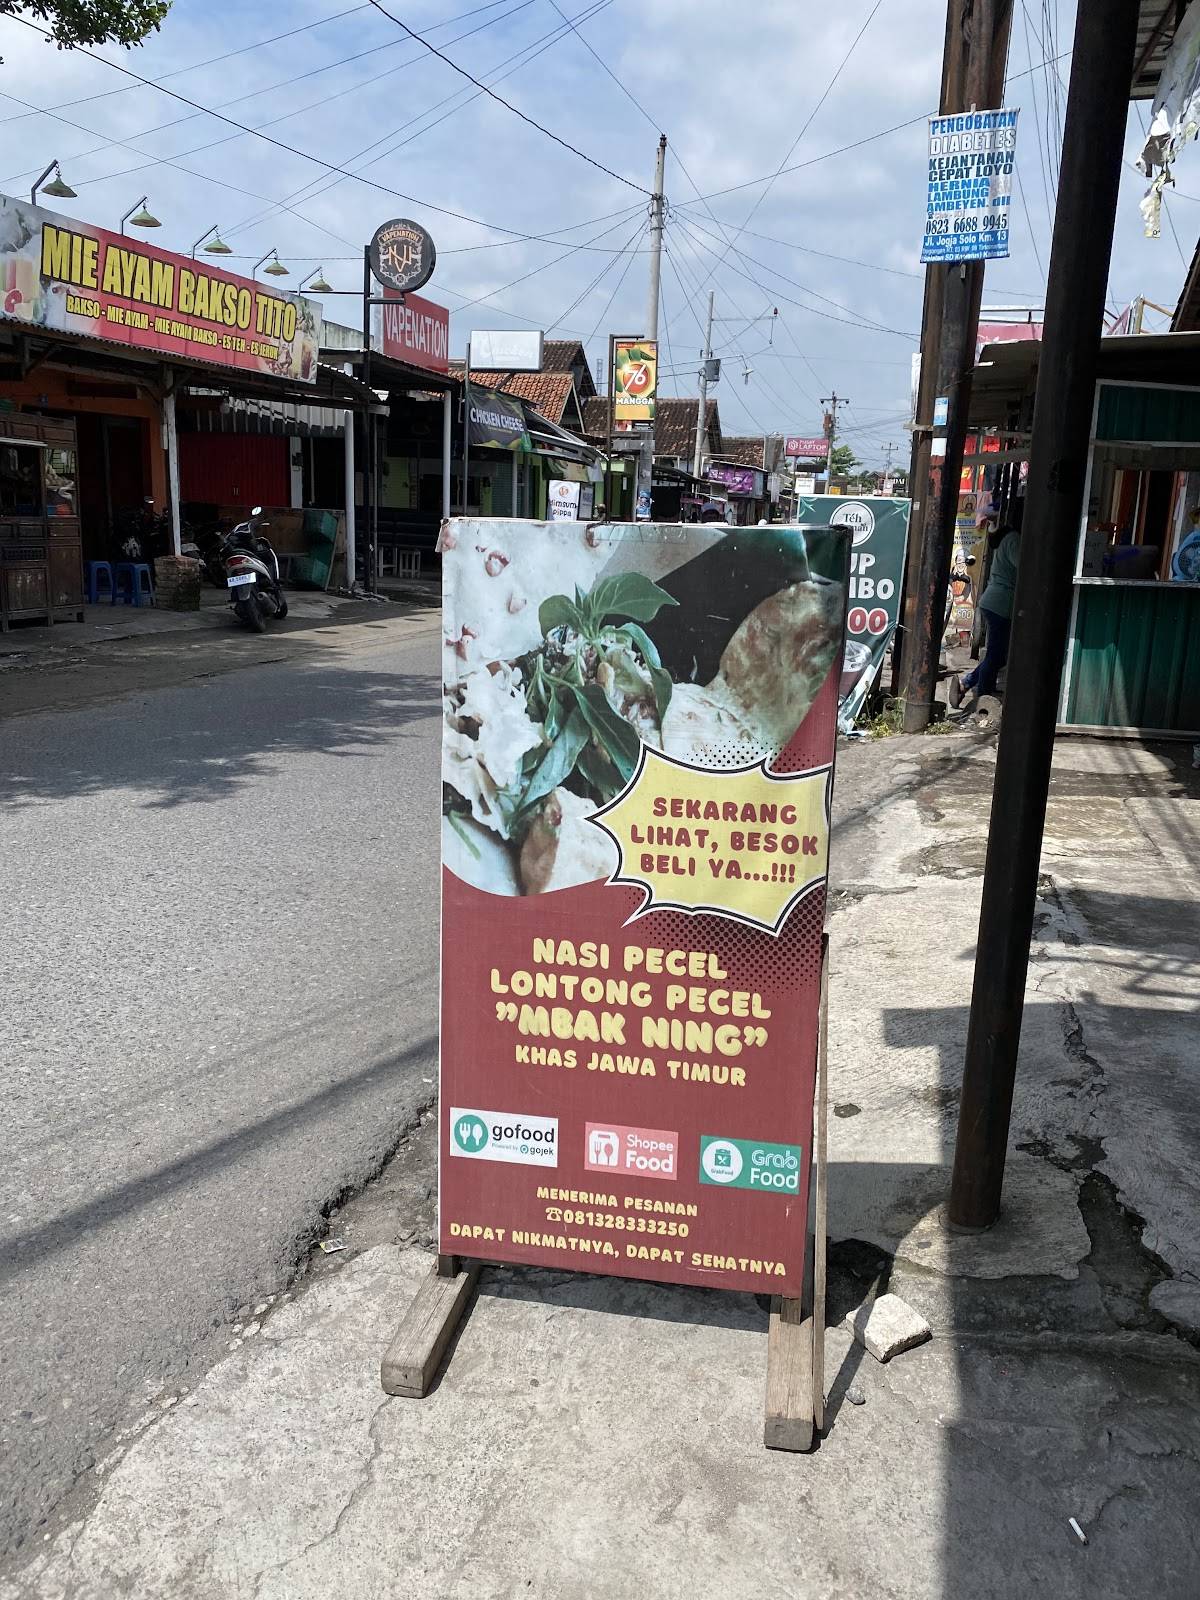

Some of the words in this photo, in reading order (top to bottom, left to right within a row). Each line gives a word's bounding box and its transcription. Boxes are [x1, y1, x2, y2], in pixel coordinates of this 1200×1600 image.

[931, 112, 1017, 135] PENGOBATAN
[930, 129, 1016, 155] DIABETES
[928, 150, 1015, 170] KEJANTANAN
[928, 167, 972, 182] CEPAT
[976, 164, 1013, 177] LOYO
[927, 188, 989, 203] LAMBUNG
[928, 177, 990, 193] HERNIA
[382, 229, 420, 242] VAPENATION
[926, 219, 949, 235] 0823
[954, 214, 977, 233] 6688
[983, 213, 1007, 230] 9945
[936, 236, 957, 248] Jogja
[959, 234, 977, 244] Solo
[997, 231, 1007, 240] 13
[42, 223, 99, 290] MIE
[102, 245, 174, 309] AYAM
[178, 268, 251, 330] BAKSO
[256, 292, 297, 343] TITO
[66, 294, 100, 319] BAKSO
[107, 304, 124, 325] MIE
[124, 309, 149, 330] AYAM
[154, 316, 171, 335] MIE
[171, 320, 192, 340] AYAM
[193, 326, 218, 347] BAKSO
[222, 335, 231, 349] ES
[231, 336, 246, 352] TEH
[251, 340, 259, 355] ES
[384, 303, 448, 360] VAPENATION
[624, 364, 646, 391] 76
[615, 397, 654, 405] MANGGA
[470, 407, 501, 428] CHICKEN
[500, 414, 525, 432] CHEESE
[552, 508, 571, 517] pippa
[652, 796, 798, 825] SEKARANG
[630, 824, 718, 853] LIHAT,
[730, 831, 819, 856] BESOK
[640, 853, 697, 876] BELI
[708, 858, 796, 884] YA...!!!
[532, 937, 610, 970] NASI
[623, 945, 728, 980] PECEL
[490, 968, 652, 1007] LONTONG
[666, 984, 772, 1019] PECEL
[515, 1044, 578, 1068] KHAS
[587, 1052, 657, 1077] JAWA
[666, 1060, 747, 1086] TIMUR
[492, 1124, 555, 1143] gofood
[626, 1133, 674, 1152] Shopee
[530, 1146, 554, 1157] gojek
[625, 1149, 674, 1173] Food
[751, 1149, 798, 1169] Grab
[710, 1167, 734, 1176] GrabFood
[750, 1167, 799, 1189] Food
[536, 1186, 618, 1208] MENERIMA
[624, 1196, 698, 1217] PESANAN
[563, 1208, 689, 1238] 081328333250
[450, 1222, 505, 1242] DAPAT
[512, 1230, 620, 1258] NIKMATNYA,
[626, 1244, 685, 1263] DAPAT
[691, 1252, 787, 1276] SEHATNYA
